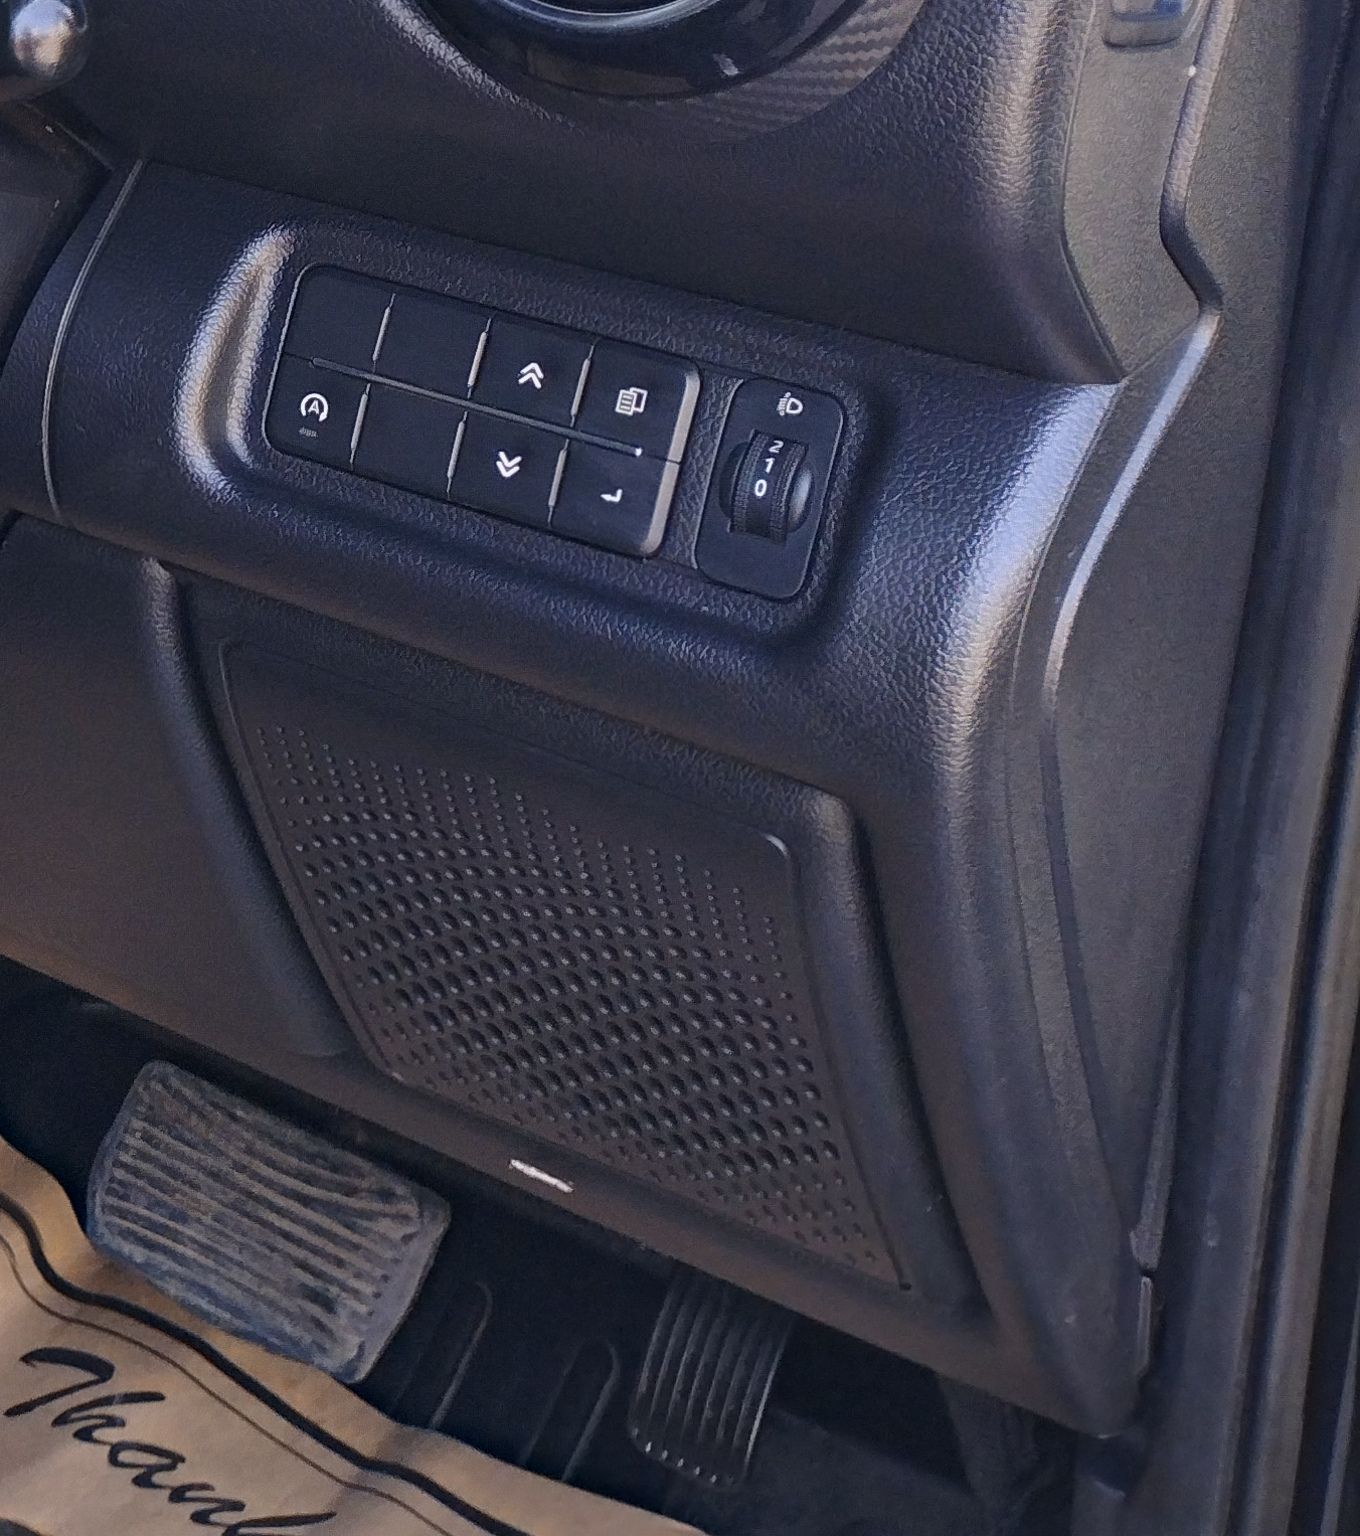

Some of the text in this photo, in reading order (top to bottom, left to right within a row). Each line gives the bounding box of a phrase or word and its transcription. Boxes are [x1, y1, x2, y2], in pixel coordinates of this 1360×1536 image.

[768, 439, 784, 454] 2
[764, 457, 776, 474] 1
[754, 479, 768, 497] 0
